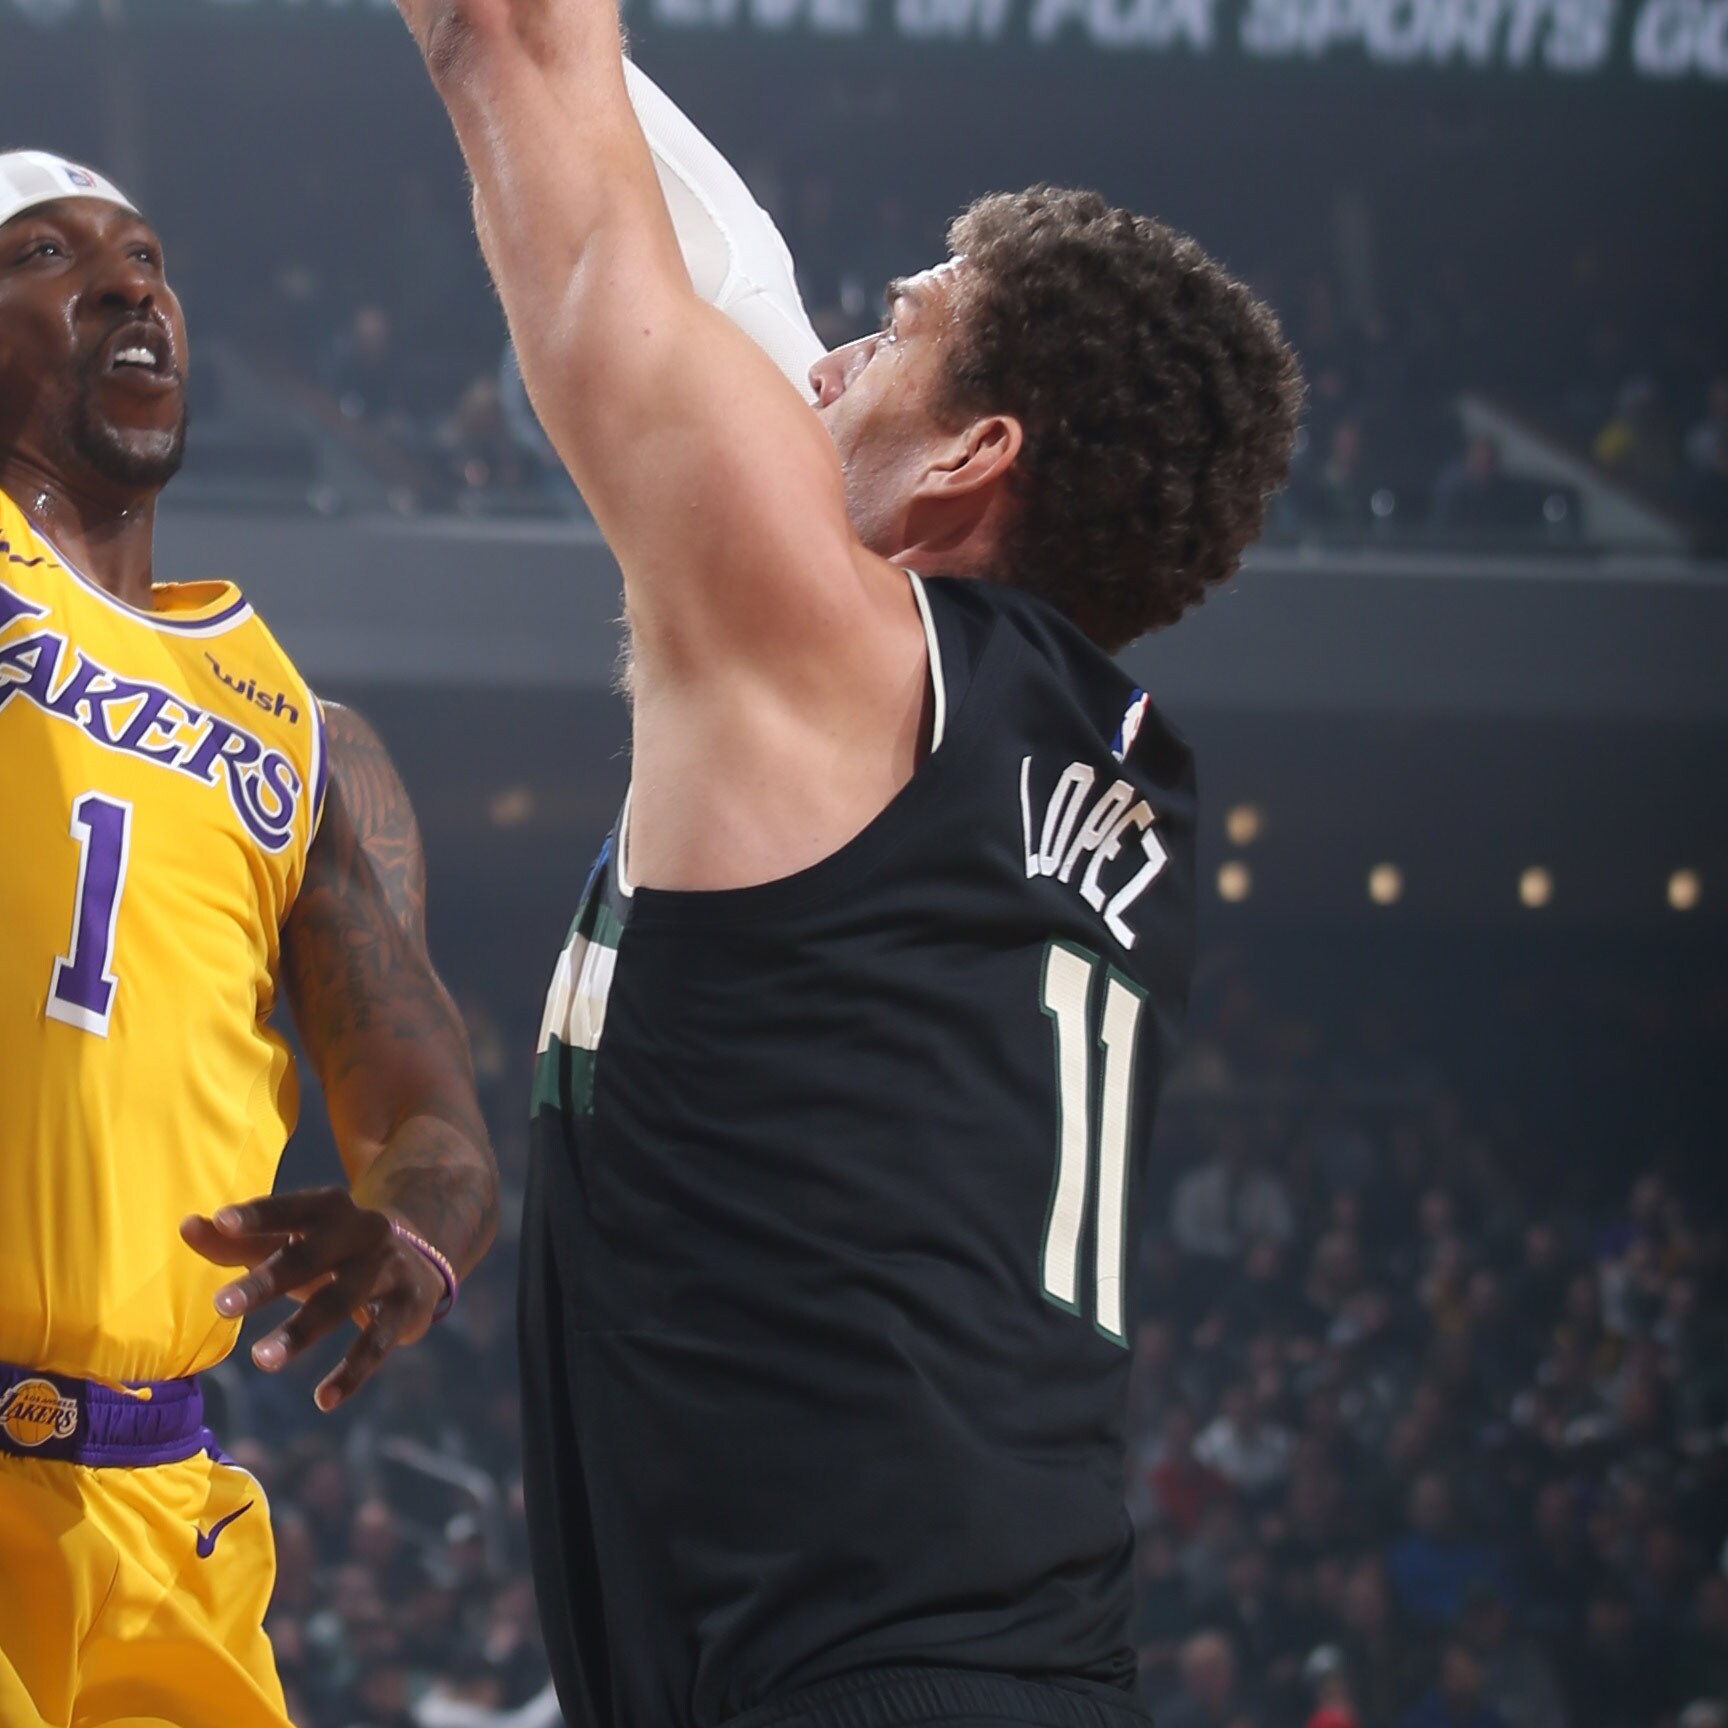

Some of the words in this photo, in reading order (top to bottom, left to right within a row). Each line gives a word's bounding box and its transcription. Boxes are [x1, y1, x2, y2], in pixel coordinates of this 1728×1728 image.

[204, 651, 299, 725] wish
[45, 789, 134, 1038] 1
[1020, 755, 1168, 950] LOPEZ
[1040, 939, 1149, 1350] 11
